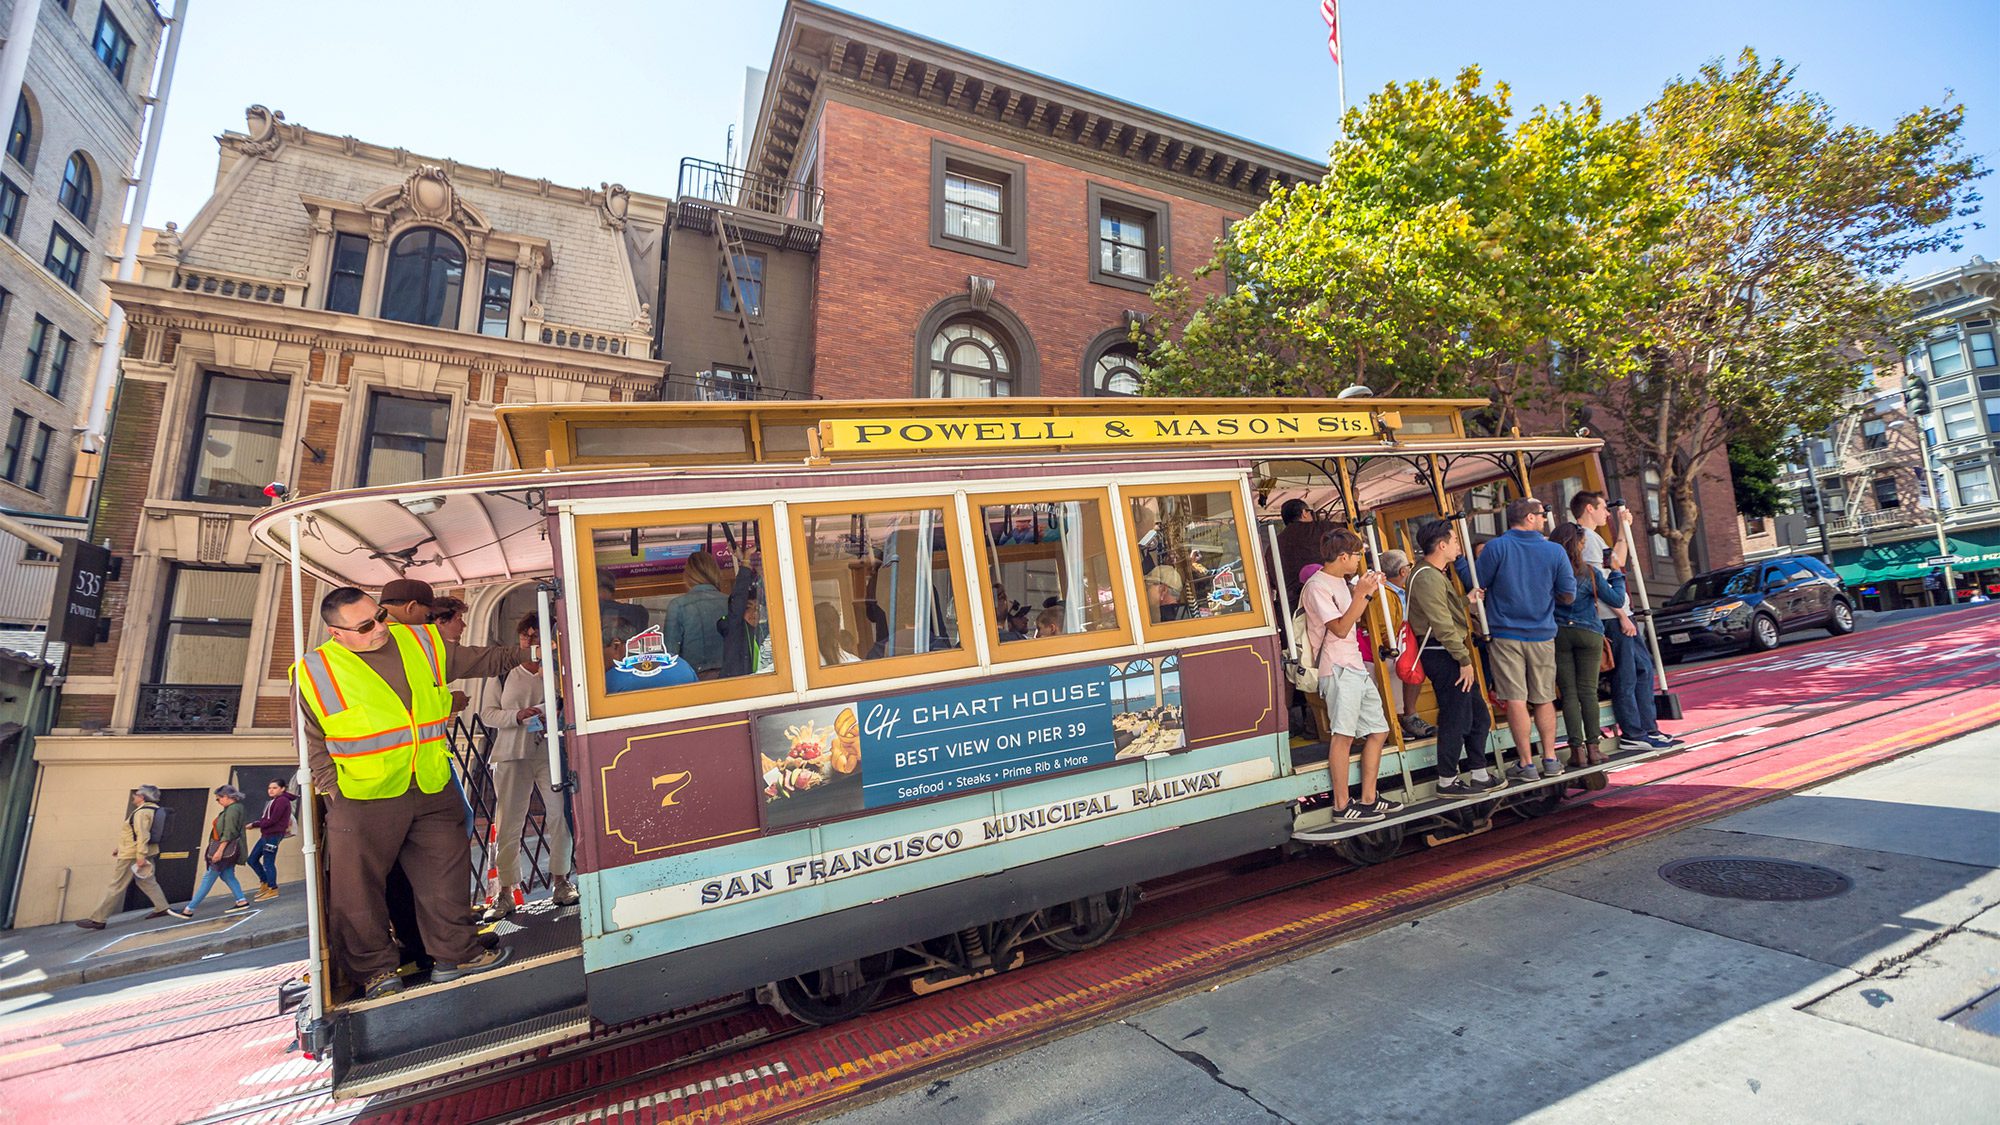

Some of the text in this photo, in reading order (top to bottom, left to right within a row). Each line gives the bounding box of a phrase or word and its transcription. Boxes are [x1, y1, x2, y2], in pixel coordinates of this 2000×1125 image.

[854, 416, 1368, 443] POWELL & MASON Sts.
[76, 570, 102, 597] 535
[69, 603, 97, 619] POWELL
[913, 696, 1003, 725] CHART
[1013, 682, 1101, 710] HOUSE
[895, 722, 1086, 768] BEST VIEW ON PIER 39
[651, 770, 692, 807] 7
[898, 754, 1089, 799] Seafood Steaks Prime Rib & More
[701, 770, 1223, 905] SAN FRANCISCO MUNICIPAL RAILWAY
